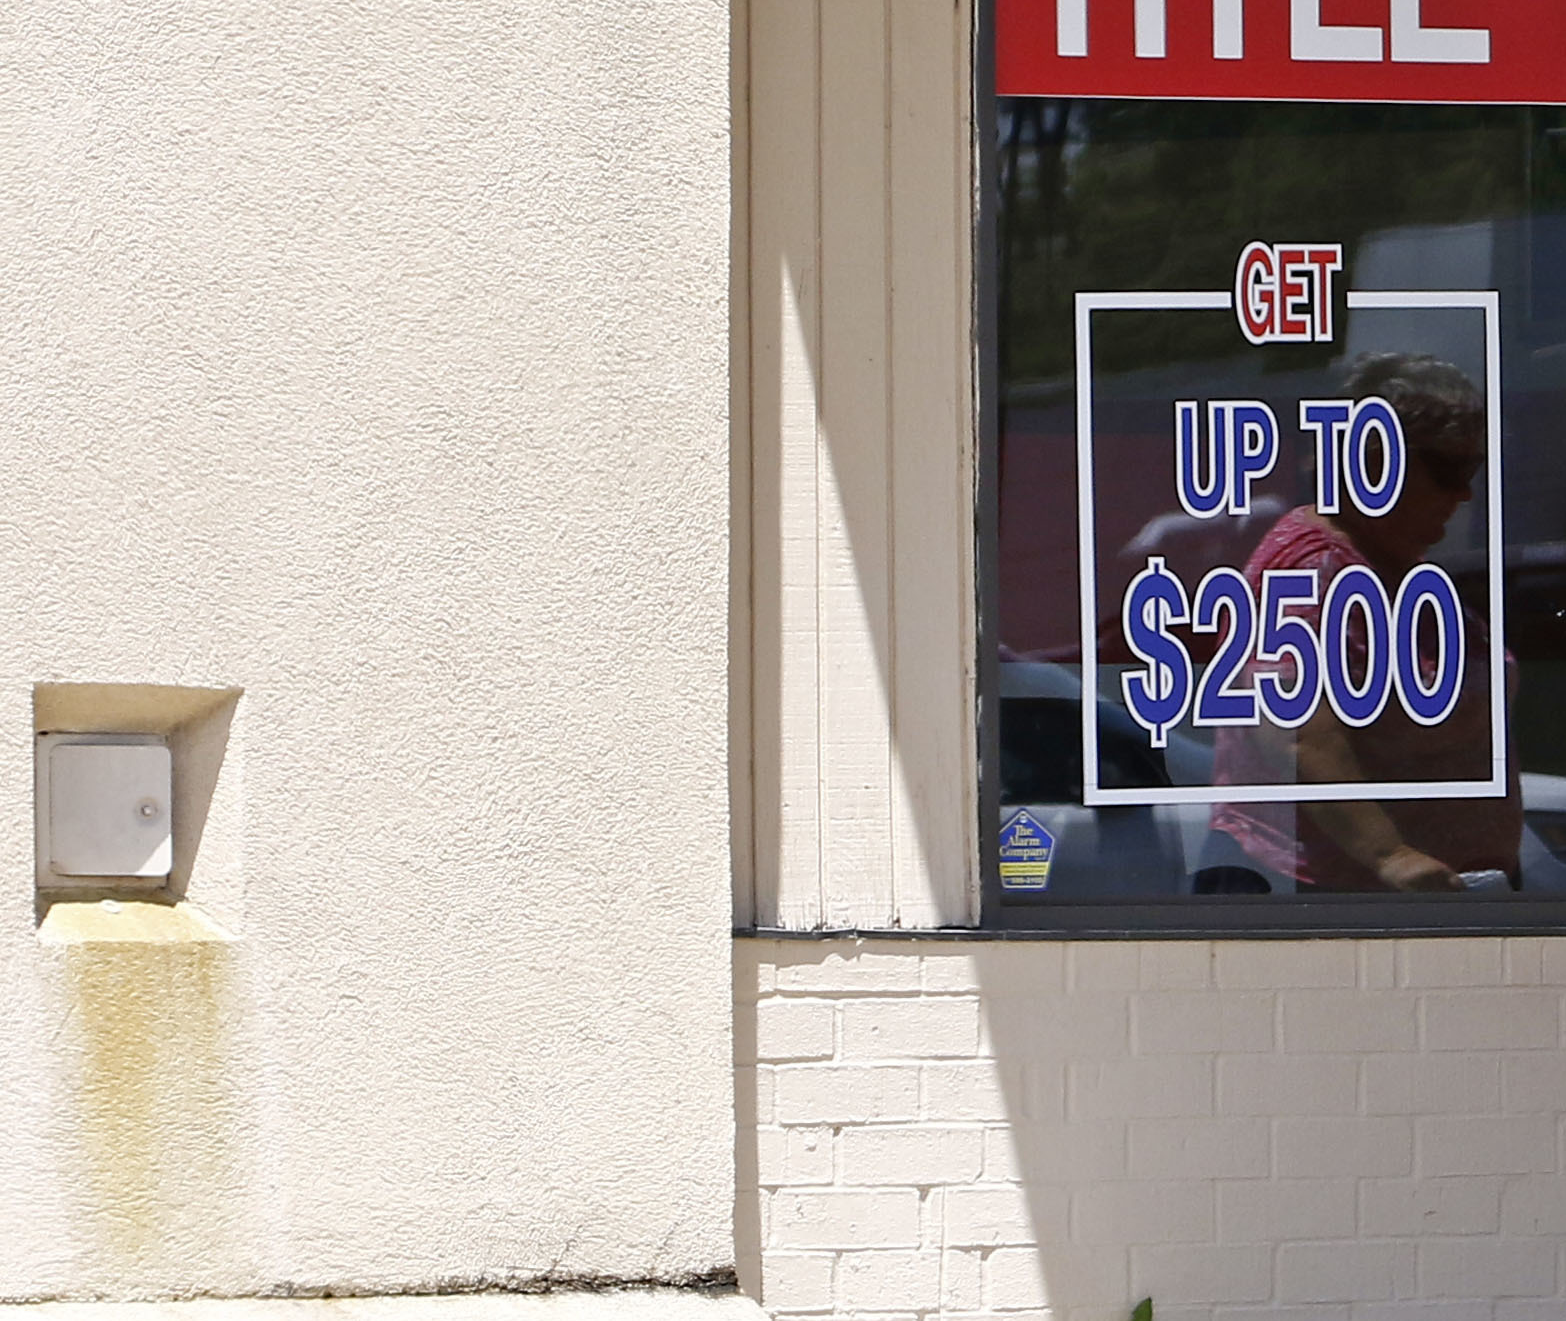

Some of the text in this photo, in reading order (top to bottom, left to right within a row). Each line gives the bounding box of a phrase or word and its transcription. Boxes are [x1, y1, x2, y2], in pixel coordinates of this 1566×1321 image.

[1235, 241, 1342, 344] GET
[1175, 396, 1406, 518] UP TO
[1121, 557, 1465, 748] $2500
[1000, 847, 1048, 860] Company
[1007, 836, 1040, 847] Alarm
[1014, 825, 1033, 837] The
